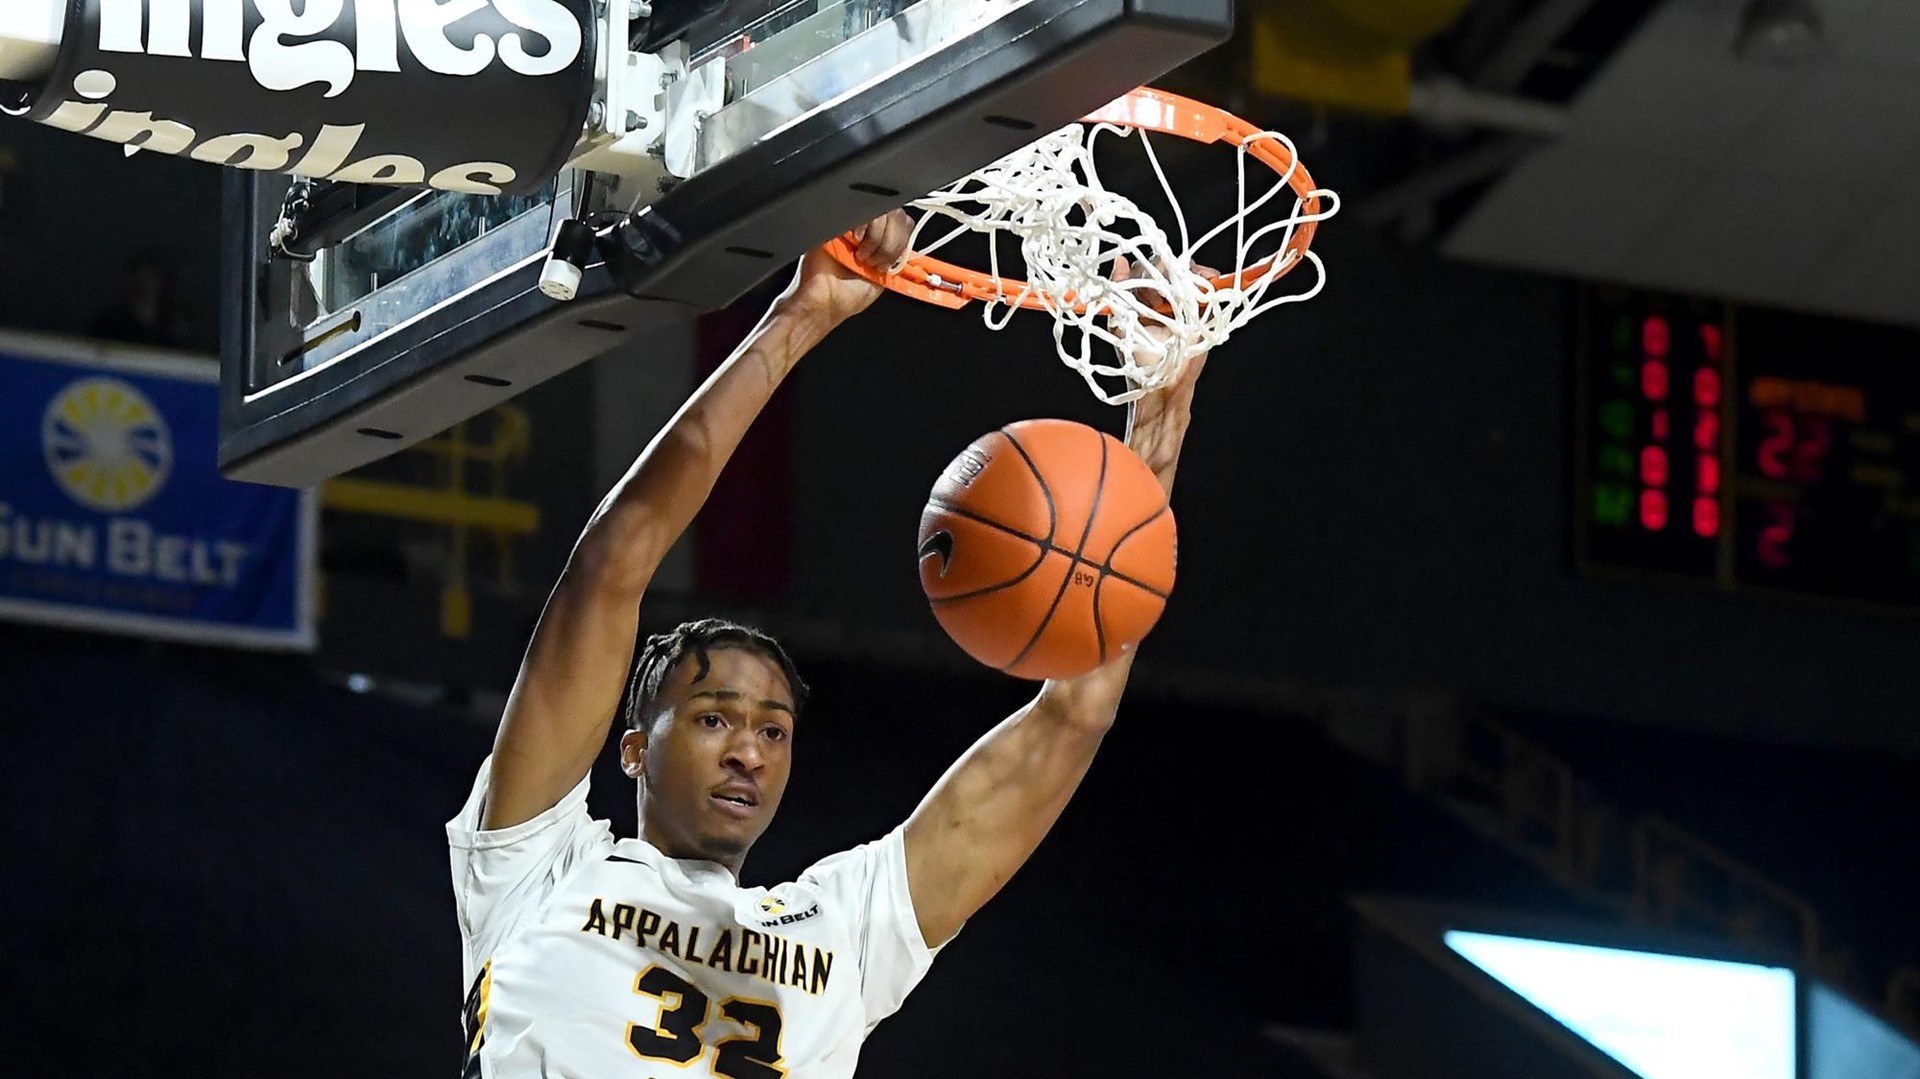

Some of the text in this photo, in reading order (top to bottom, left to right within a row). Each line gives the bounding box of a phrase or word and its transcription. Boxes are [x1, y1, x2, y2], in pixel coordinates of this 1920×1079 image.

[106, 516, 248, 589] BELT
[580, 898, 834, 996] APPALACHIAN
[780, 904, 818, 925] BELT
[624, 963, 789, 1079] 32
